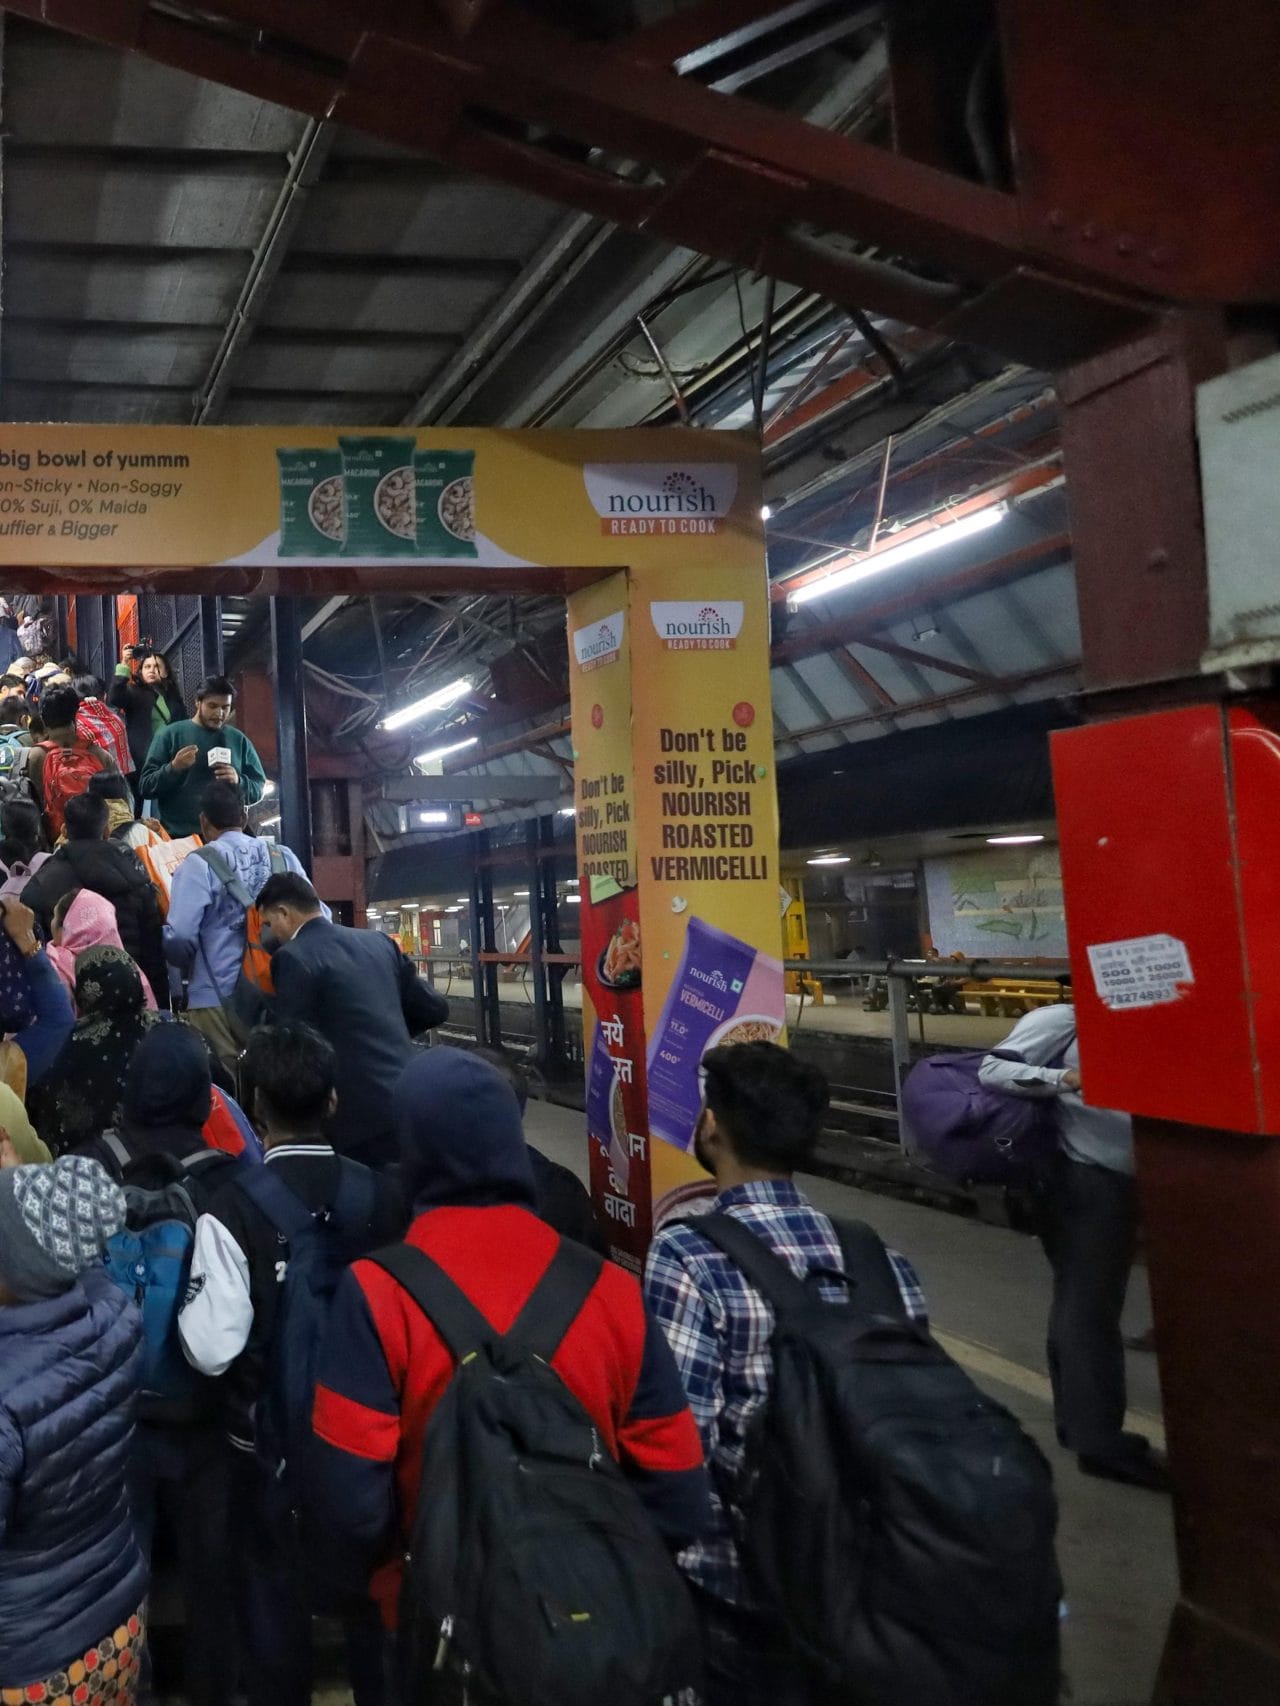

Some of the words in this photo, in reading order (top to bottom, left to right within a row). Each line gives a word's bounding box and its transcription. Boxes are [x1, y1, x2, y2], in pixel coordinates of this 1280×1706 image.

[37, 449, 86, 468] bowl
[93, 450, 113, 468] of
[116, 453, 190, 471] yummm
[87, 479, 183, 497] Non-Soggy
[608, 486, 716, 513] nourish
[30, 499, 63, 517] Suji,
[68, 499, 94, 514] 0%
[99, 500, 148, 515] Maida
[60, 520, 119, 541] Bigger
[611, 519, 656, 534] READY
[659, 519, 676, 533] TO
[680, 519, 716, 533] COOK
[666, 618, 731, 636] nourish
[580, 633, 617, 660] nourish
[668, 639, 695, 650] READY
[696, 639, 706, 650] TO
[708, 638, 730, 649] COOK
[660, 728, 715, 753] Don't
[722, 728, 747, 753] be
[581, 776, 609, 800] Don't
[610, 772, 625, 792] be
[654, 759, 706, 788] silly,
[712, 760, 757, 785] Pick
[578, 805, 604, 830] silly,
[606, 801, 630, 824] Pick
[662, 791, 751, 817] NOURISH
[582, 829, 627, 856] NOURISH
[662, 823, 753, 849] ROASTED
[651, 855, 768, 881] VERMICELLI
[689, 966, 728, 993] nourish
[680, 988, 725, 1022] VERMICELLI
[601, 1014, 625, 1047] नये
[608, 1056, 633, 1084] रत
[604, 1192, 636, 1228] वादा
